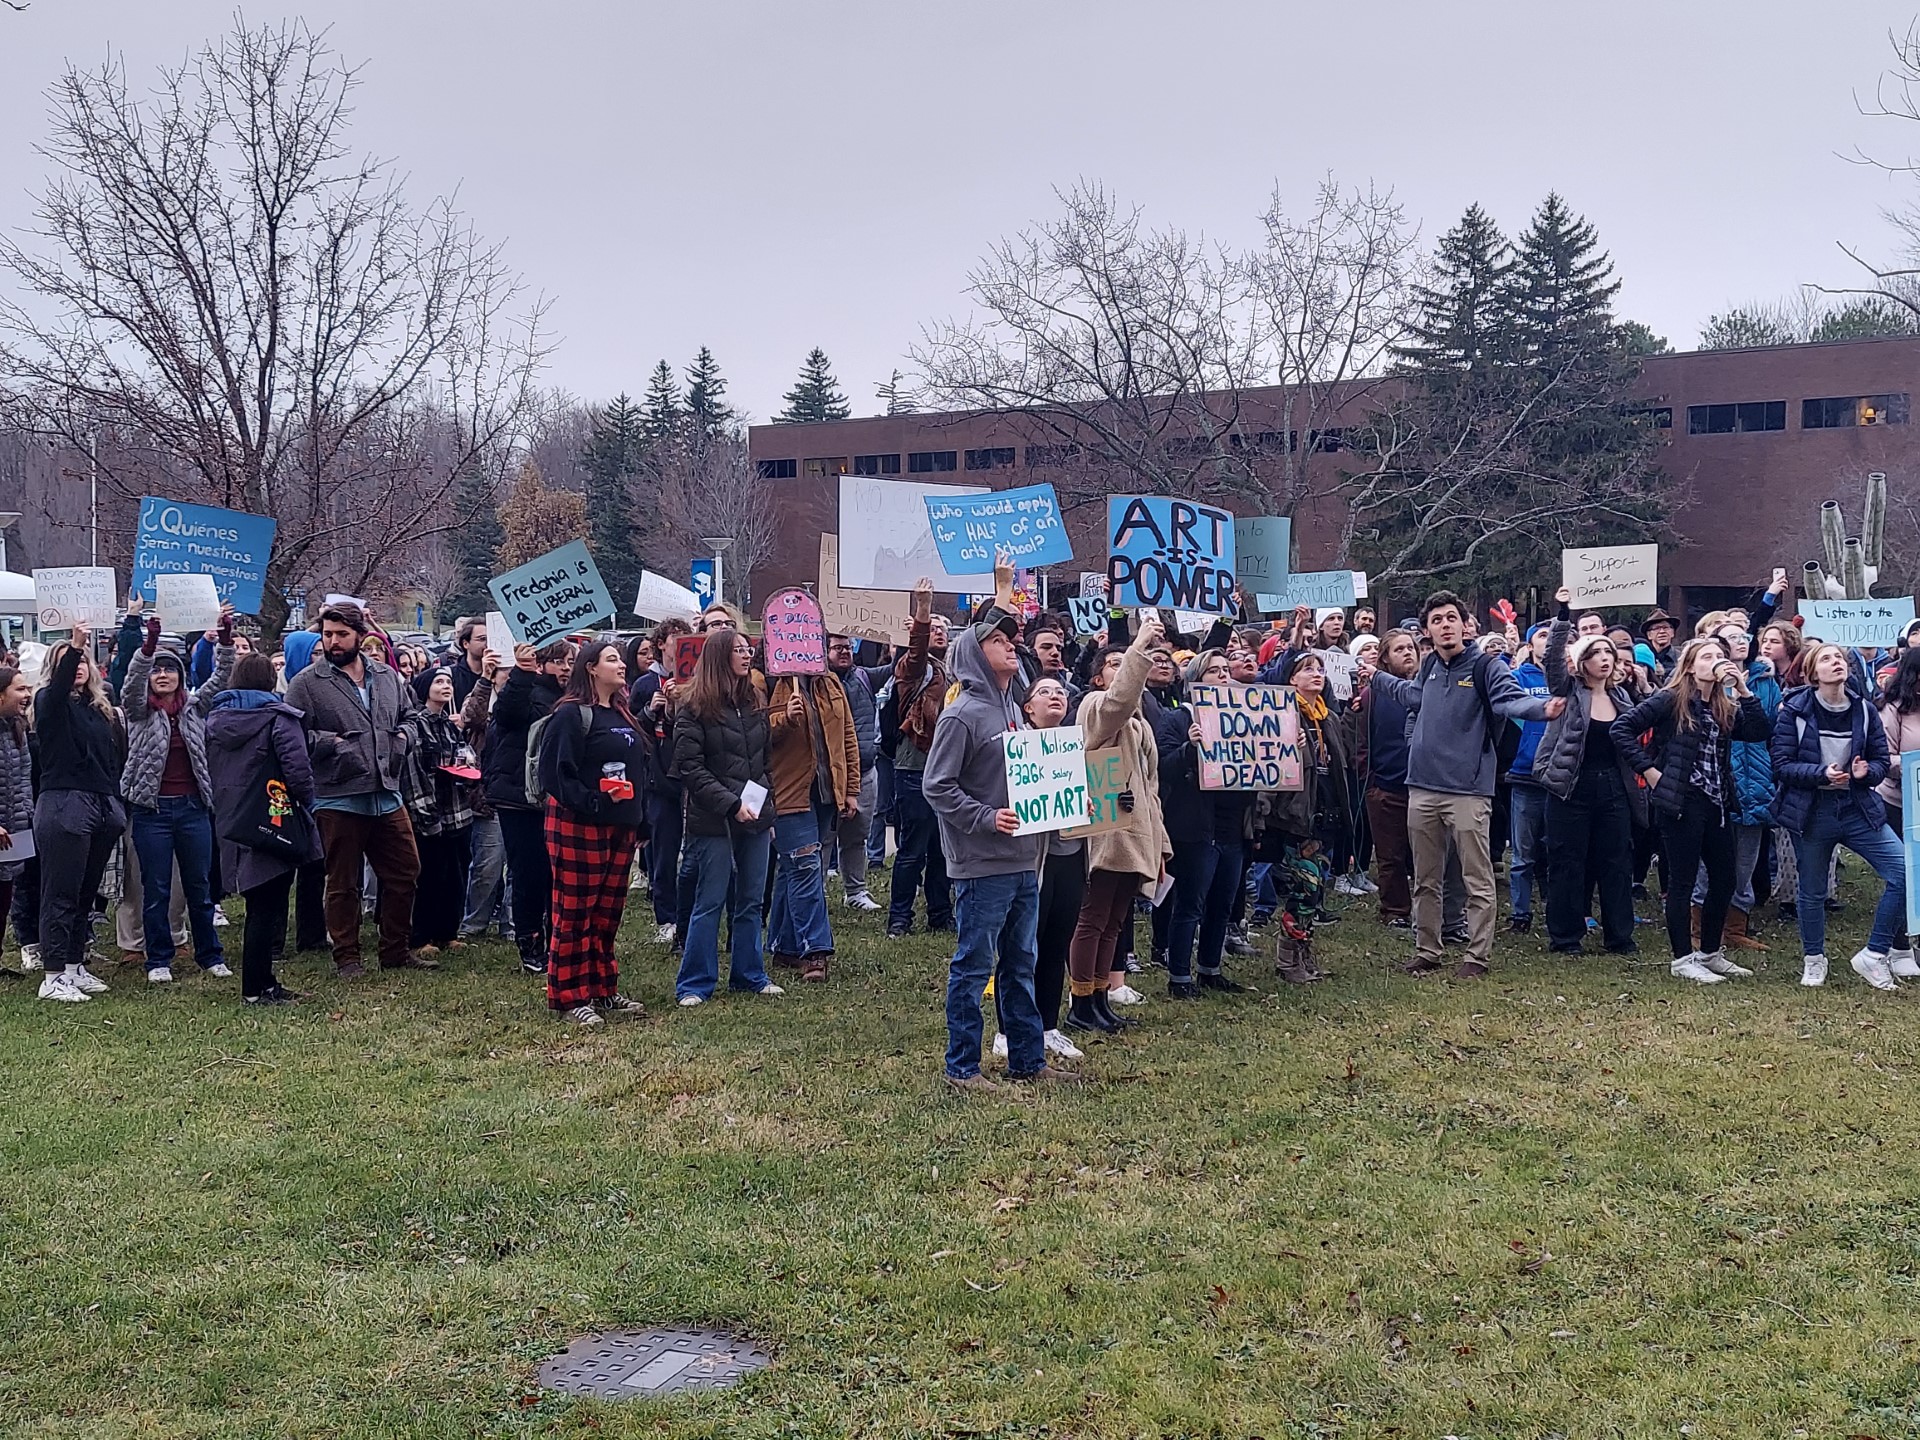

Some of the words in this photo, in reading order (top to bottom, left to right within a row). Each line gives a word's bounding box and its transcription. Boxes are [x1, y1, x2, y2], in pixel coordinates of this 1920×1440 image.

[931, 504, 963, 520] Who
[971, 499, 1015, 517] would
[1018, 495, 1053, 518] apply
[142, 500, 239, 541] ¿Quiénes
[937, 525, 957, 542] for
[1036, 517, 1059, 530] an
[1113, 498, 1229, 557] ART
[1251, 521, 1264, 537] to
[140, 534, 180, 550] Serán
[187, 542, 251, 563] nuestros
[961, 543, 989, 560] arts
[139, 552, 191, 572] futuros
[201, 563, 259, 580] maestros
[1237, 555, 1269, 573] LTY!
[1580, 553, 1639, 572] Support
[501, 568, 570, 606] Fredonia
[574, 560, 589, 576] is
[1107, 555, 1238, 616] POWER
[1304, 574, 1324, 584] CUT
[1588, 574, 1612, 584] the
[50, 593, 69, 606] NO
[76, 593, 109, 606] MORE
[516, 611, 530, 625] a
[535, 583, 594, 614] LIBERAL
[1075, 597, 1106, 617] NO
[1814, 605, 1856, 619] Listen
[1860, 606, 1872, 618] to
[1878, 606, 1893, 618] the
[523, 616, 554, 642] ARTS
[555, 598, 598, 625] School
[1832, 623, 1901, 643] STUDENTS
[774, 648, 823, 663] Grave
[1334, 665, 1348, 675] ME
[1193, 686, 1242, 709] I'LL
[1245, 687, 1298, 712] CALM
[1219, 712, 1281, 739] DOWN
[1007, 735, 1030, 759] Cut
[1040, 730, 1084, 756] Kolison's
[1200, 740, 1256, 763] WHEN
[1259, 742, 1299, 763] I'M
[1087, 757, 1122, 788] VE
[1222, 763, 1280, 788] DEAD
[1014, 795, 1049, 824] NOT
[1053, 785, 1085, 819] ART
